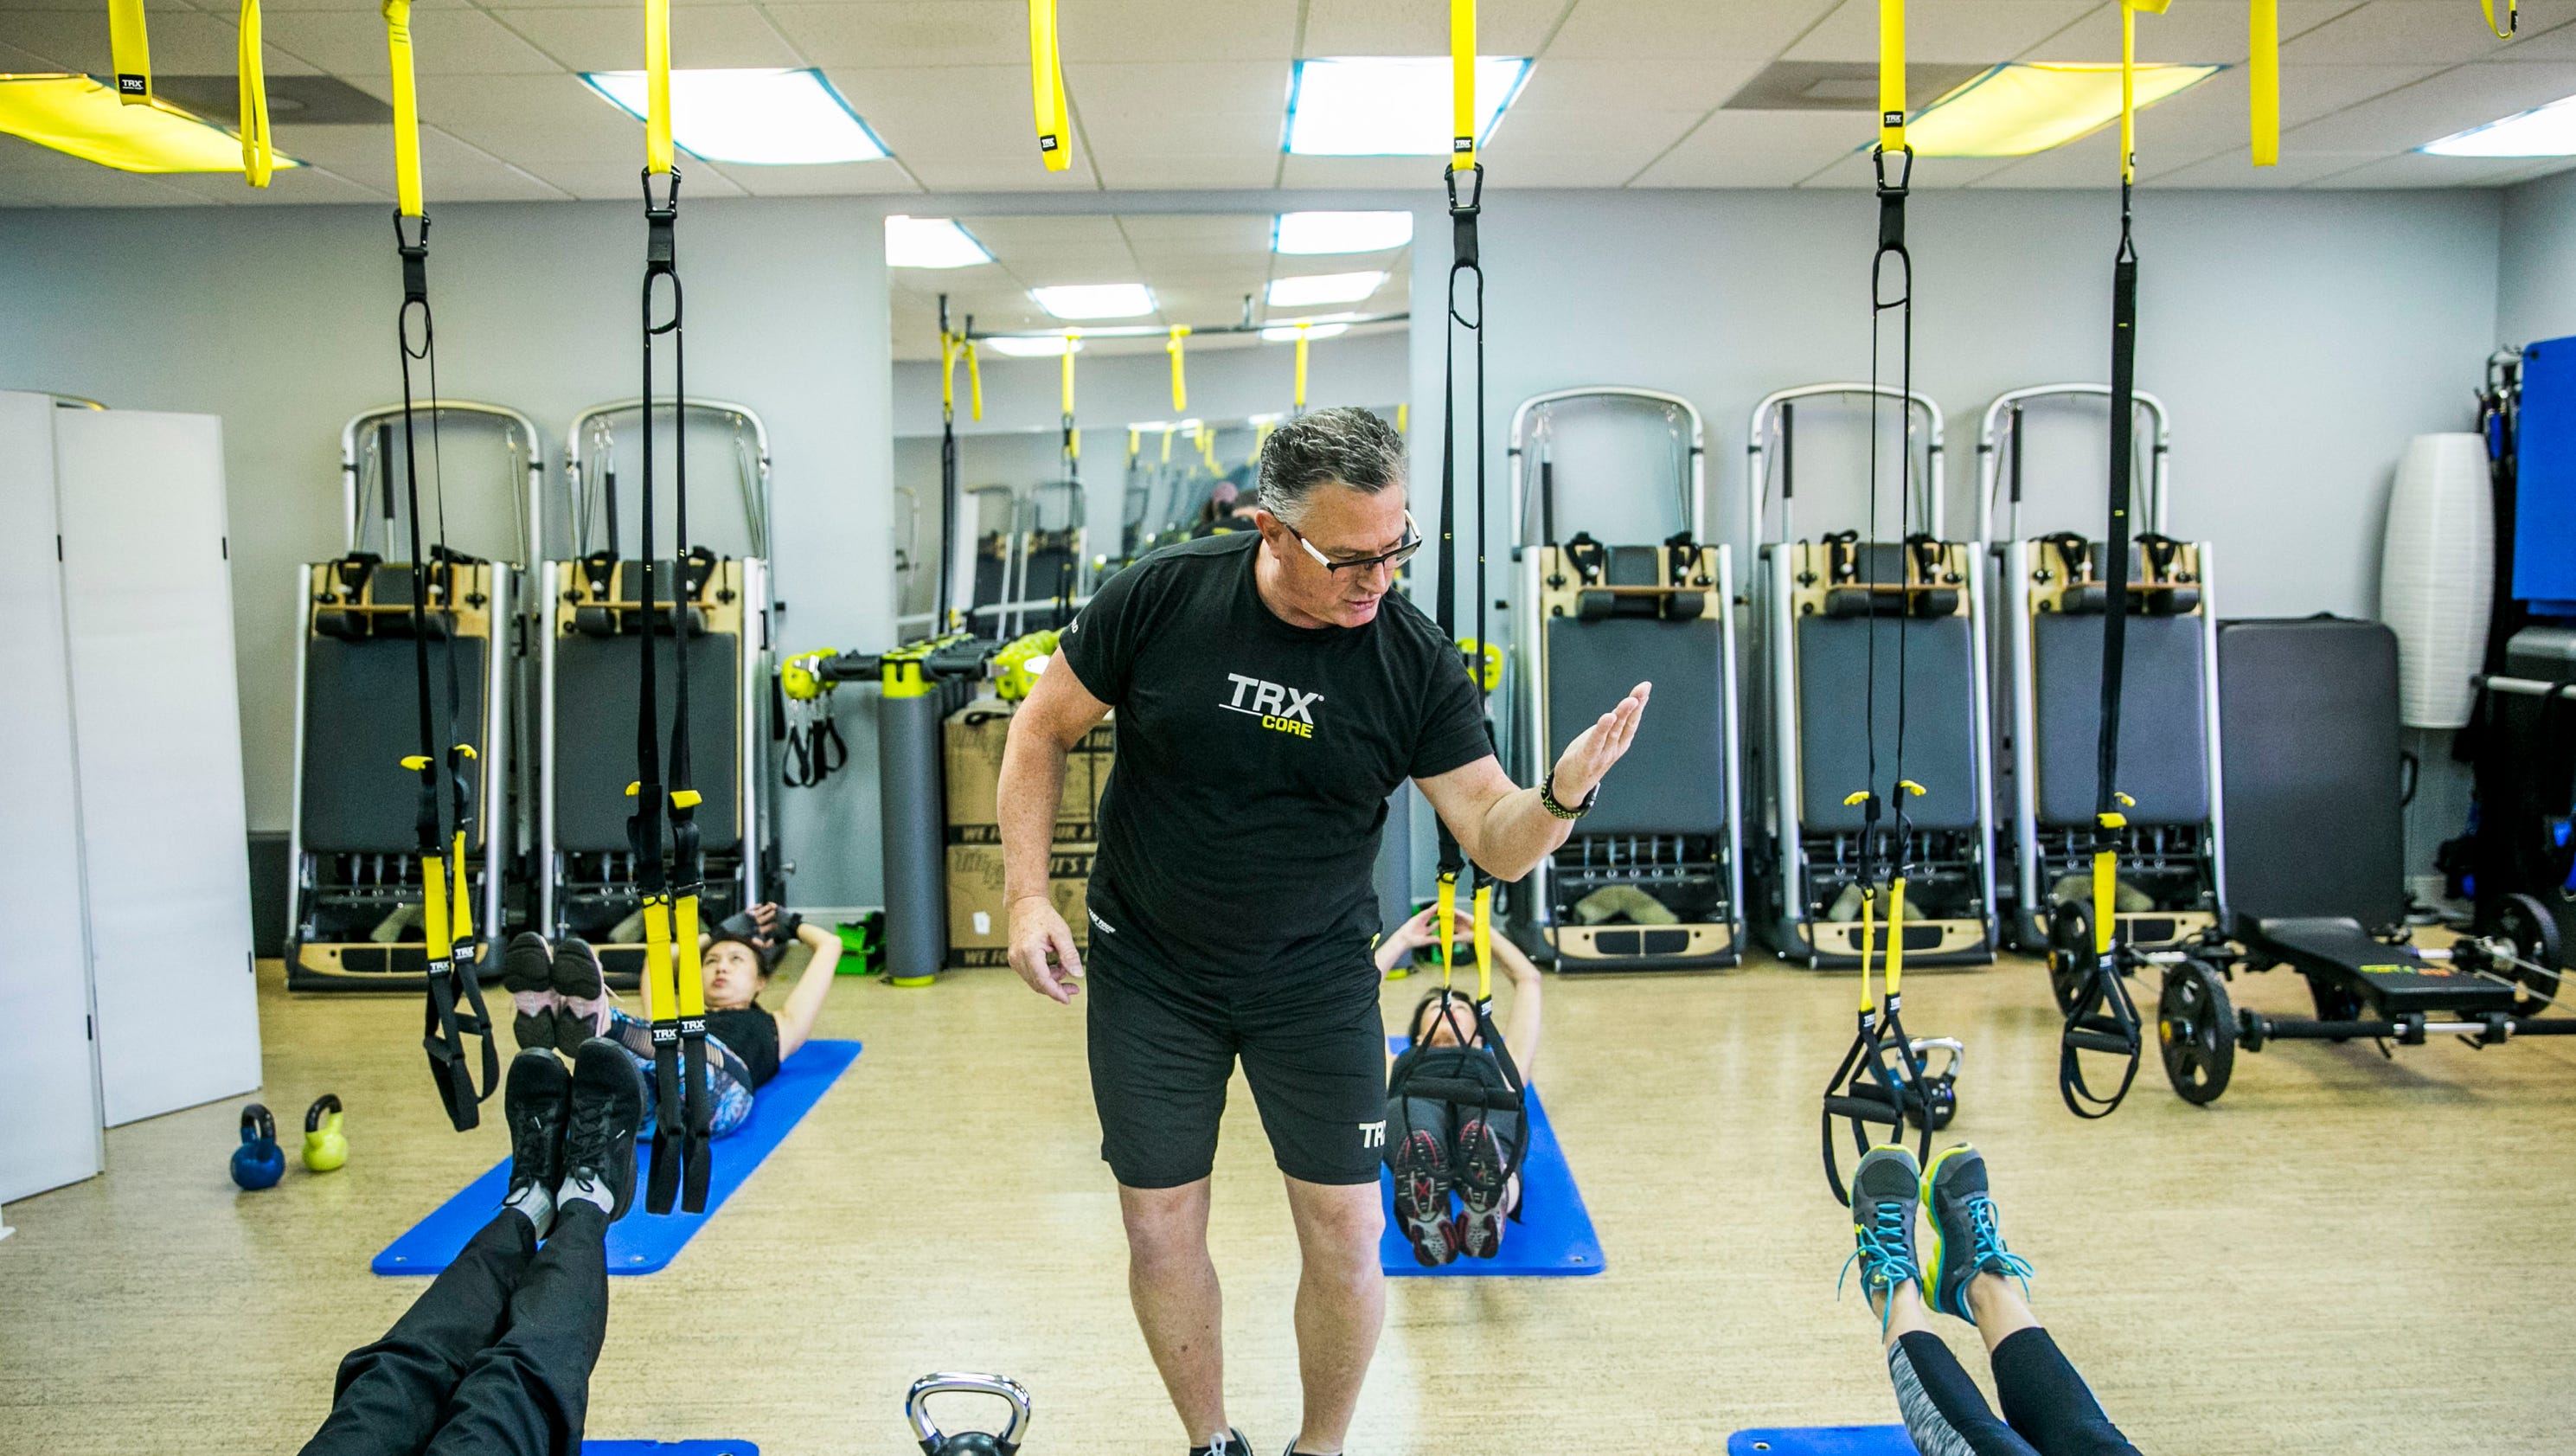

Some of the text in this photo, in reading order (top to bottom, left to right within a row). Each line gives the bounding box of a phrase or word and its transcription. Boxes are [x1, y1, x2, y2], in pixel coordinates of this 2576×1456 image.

[122, 79, 143, 87] TRX
[1228, 672, 1319, 725] TRX
[1262, 715, 1314, 739] CORE
[682, 1019, 706, 1029] TRX
[653, 1029, 677, 1038] TRX
[1359, 1119, 1387, 1148] TR
